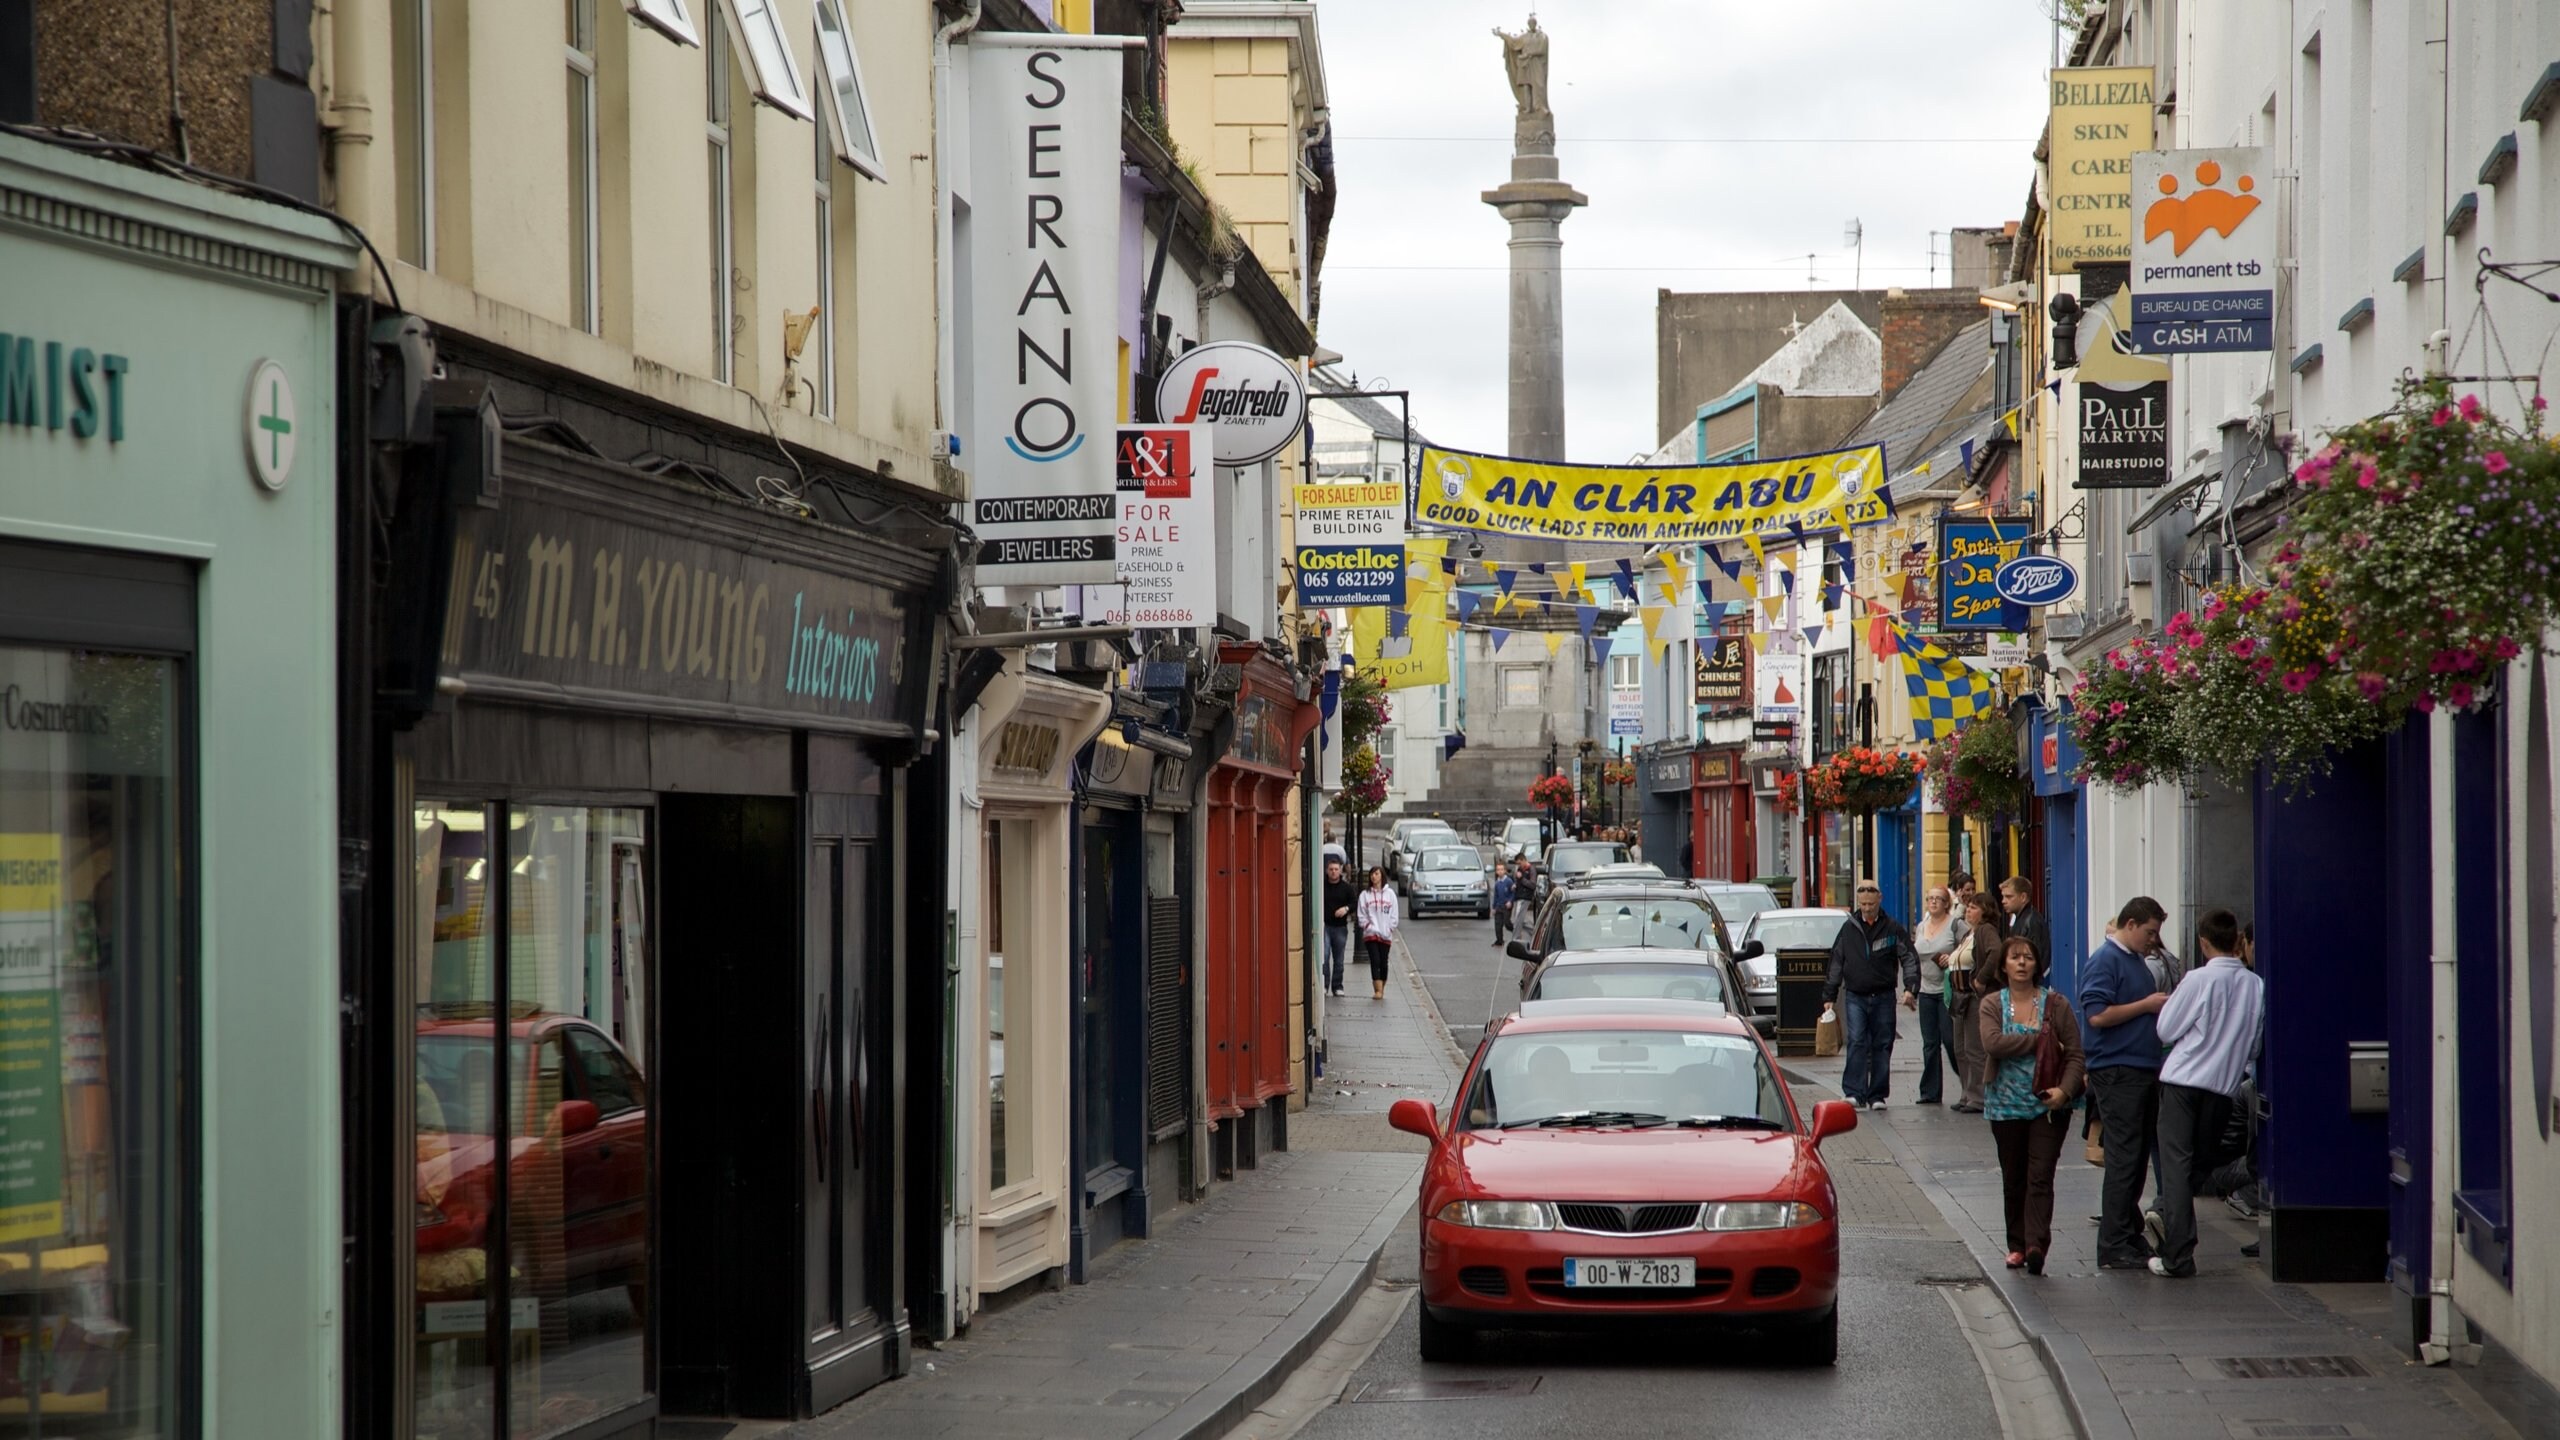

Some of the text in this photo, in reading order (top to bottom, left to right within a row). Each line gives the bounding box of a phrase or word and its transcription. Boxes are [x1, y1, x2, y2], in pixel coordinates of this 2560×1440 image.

[2053, 80, 2152, 106] BELLEZIA
[2074, 124, 2130, 140] SKIN
[2071, 159, 2131, 175] CARE
[2056, 194, 2131, 211] CENTR
[2083, 224, 2122, 238] TEL.
[1015, 52, 1075, 453] SERANO
[2056, 245, 2131, 259] 065-68646
[2144, 260, 2261, 283] permanent tsb
[2141, 298, 2264, 313] BUREAU DE CHANGE
[2153, 327, 2252, 345] CASH ATM
[1173, 368, 1289, 423] Segafredo
[1224, 417, 1266, 425] ZANETTI
[2082, 430, 2165, 443] MARTYN
[2082, 457, 2165, 469] HAIRSTUDIO
[1302, 488, 1325, 504] FOR
[1361, 486, 1377, 501] TO
[1378, 485, 1399, 501] LET
[1485, 465, 1816, 515] AN CLÁR ABÚ
[980, 497, 1110, 522] CONTEMPORARY
[1125, 505, 1170, 520] FOR
[1300, 509, 1394, 521] PRIME RETAIL
[1426, 500, 1878, 539] GOOD LUCK LADS FROM ANTHONY DALY SPRTS
[1118, 526, 1180, 542] SALE
[1313, 523, 1382, 534] BUILDING
[998, 539, 1094, 562] JEWELLERS
[1131, 547, 1163, 557] PRIME
[1116, 561, 1184, 572] EASEHOLD &
[1299, 549, 1399, 570] Costelloe
[473, 551, 505, 620] 45
[1127, 577, 1172, 588] USINESS
[1304, 571, 1394, 587] 065 6821299
[2005, 565, 2063, 595] Boots
[1310, 592, 1391, 603] www.costelloe.com
[1135, 608, 1193, 622] 6868686
[785, 590, 879, 704] Interiors
[1698, 672, 1742, 682] CHINESE
[1698, 685, 1741, 697] RESTAURANT
[6, 683, 108, 735] Cosmetics
[1788, 962, 1823, 972] LITTER
[1587, 1264, 1680, 1285] 00-W-2183
